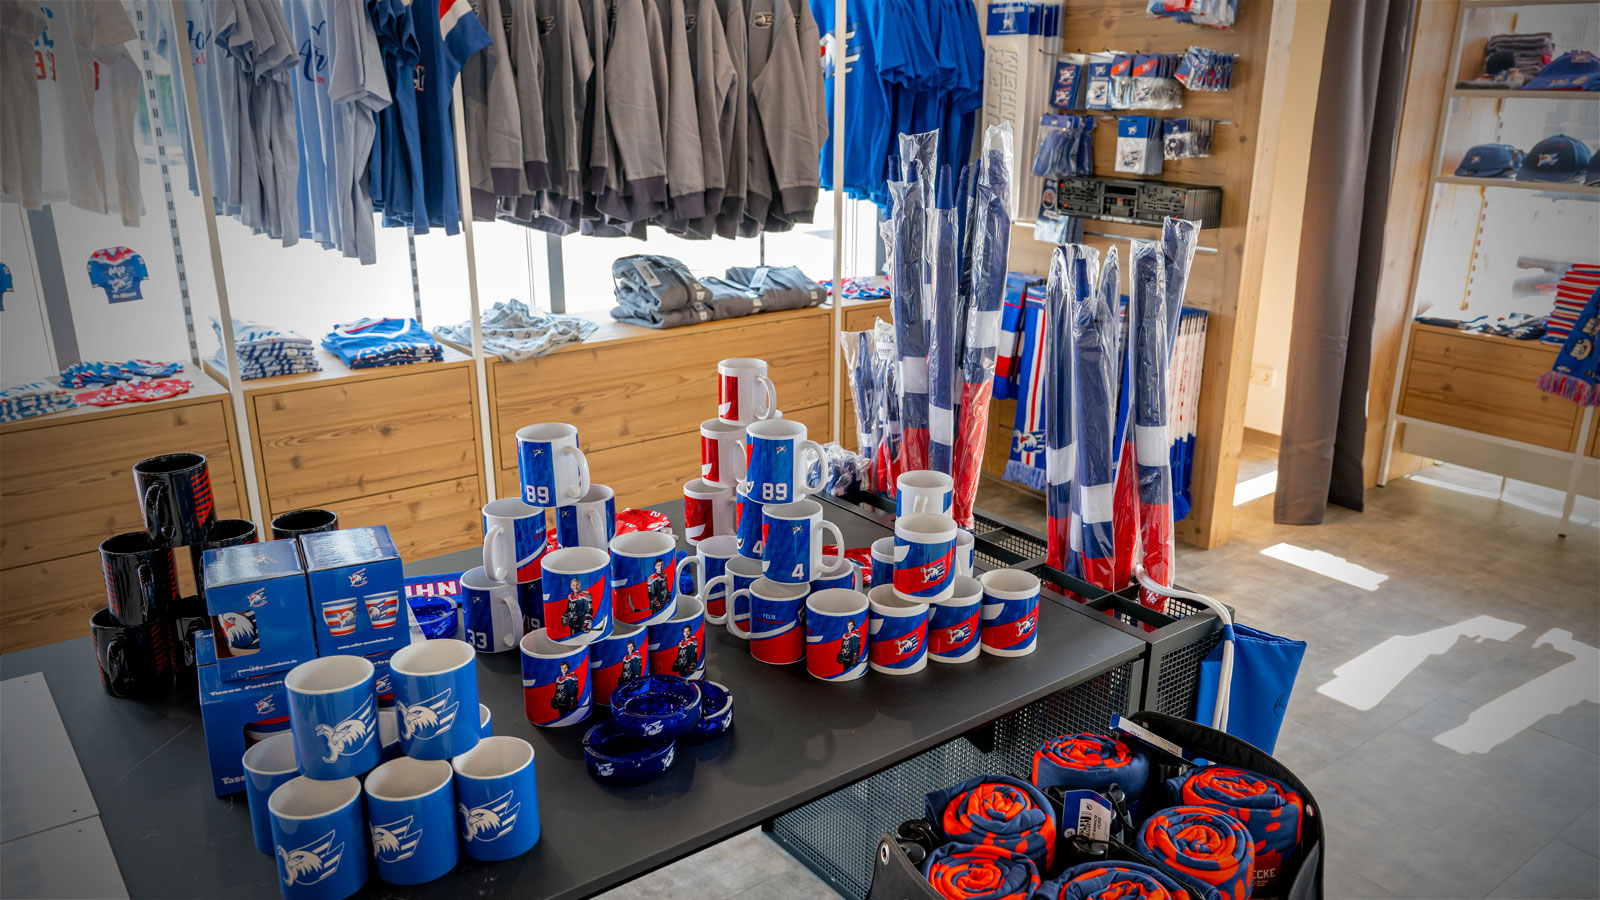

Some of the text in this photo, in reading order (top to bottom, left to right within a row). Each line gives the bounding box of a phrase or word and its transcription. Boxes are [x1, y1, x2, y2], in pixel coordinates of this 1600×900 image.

[526, 484, 550, 504] 89
[762, 482, 788, 501] 89
[791, 563, 804, 580] 4
[467, 629, 487, 649] 33
